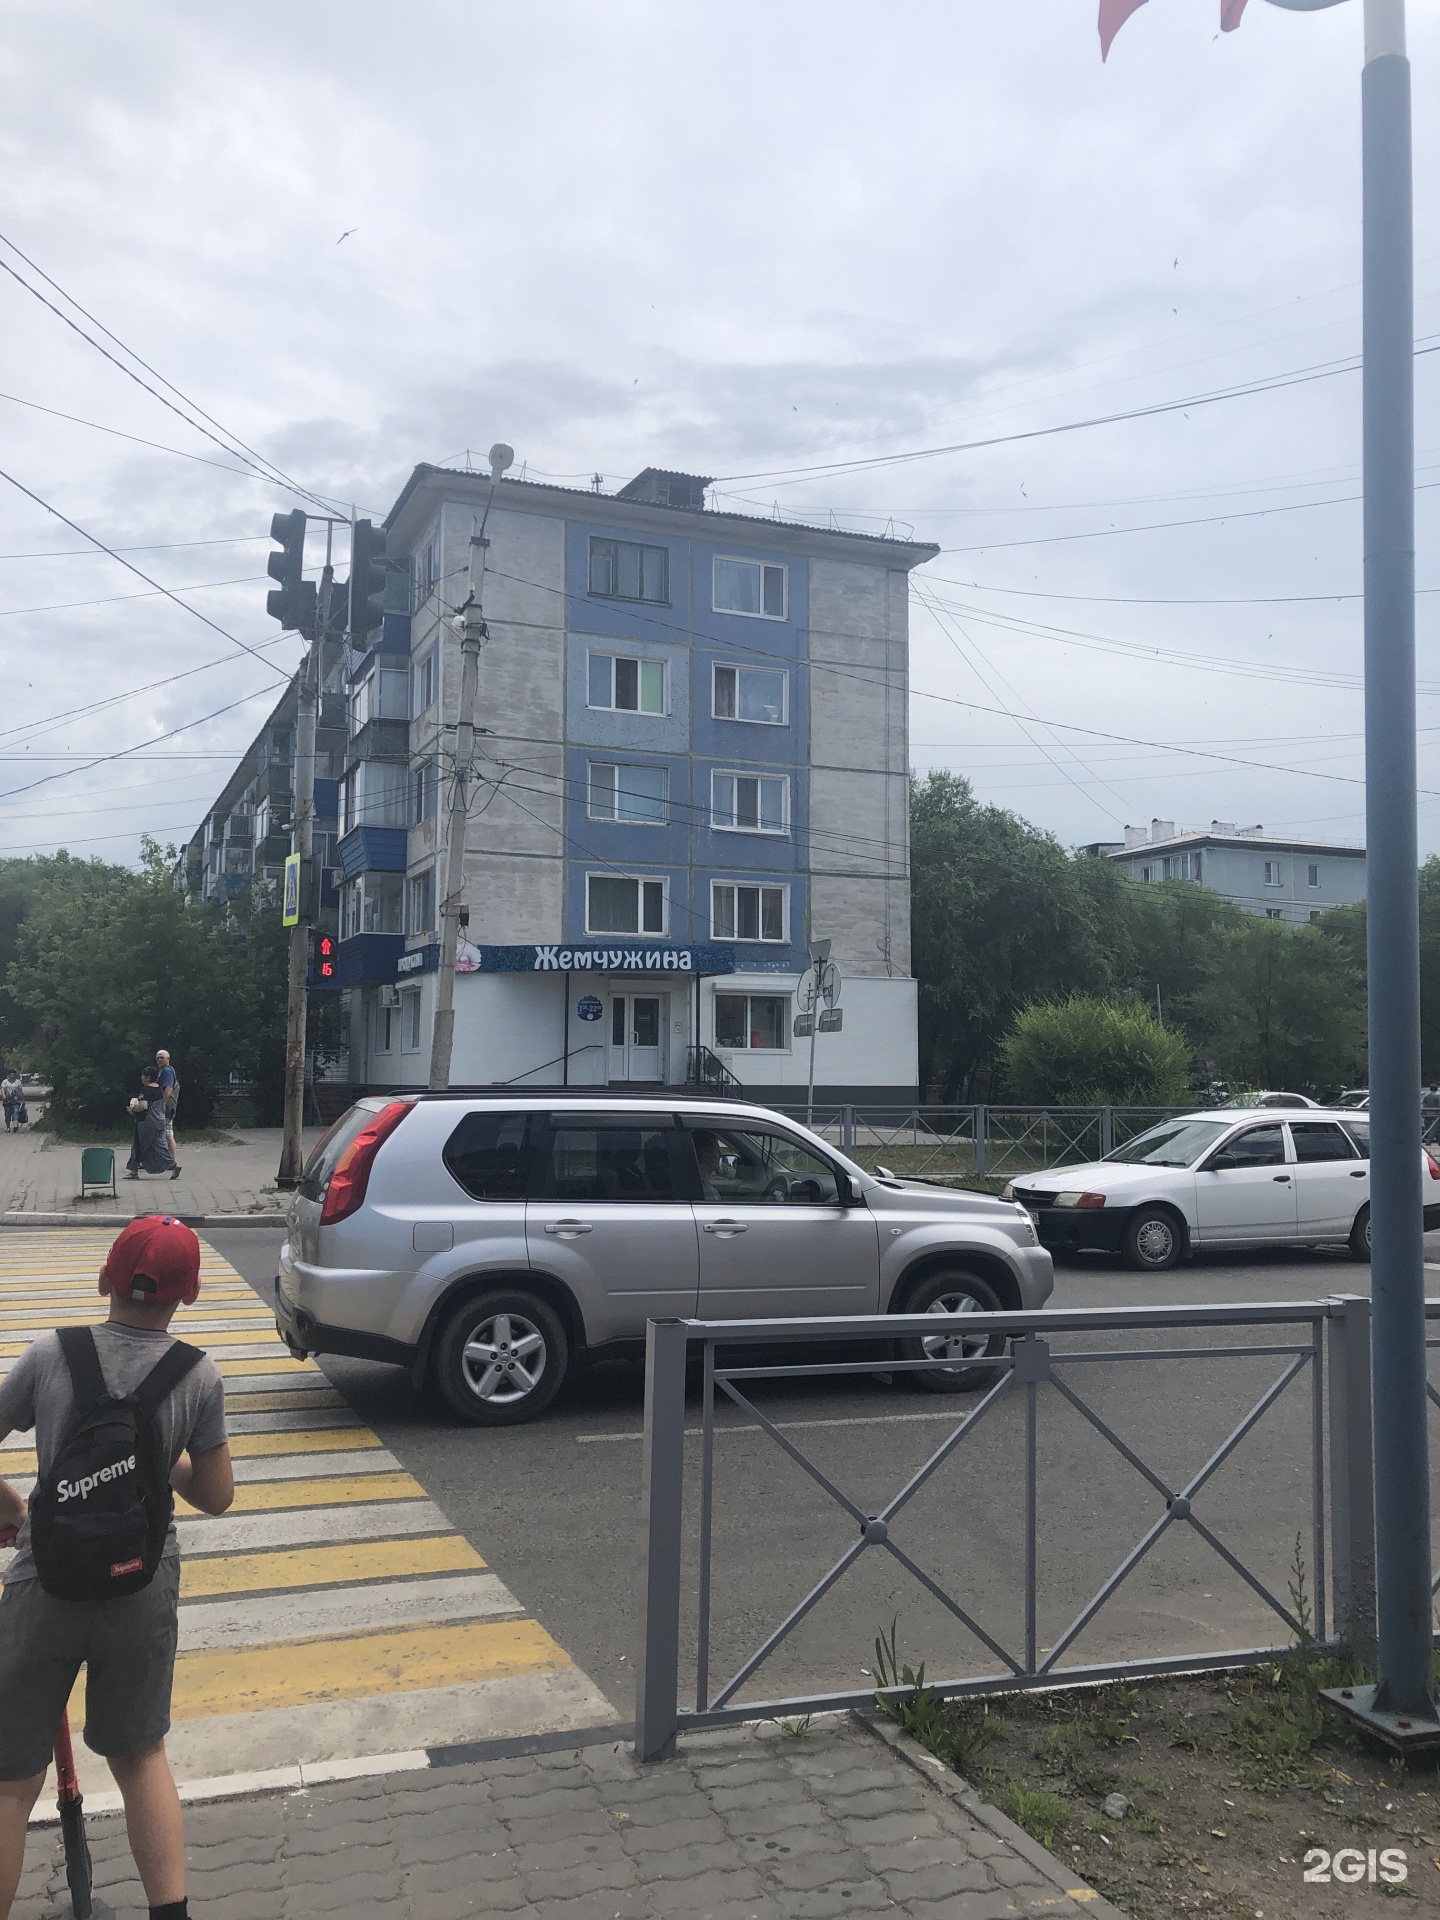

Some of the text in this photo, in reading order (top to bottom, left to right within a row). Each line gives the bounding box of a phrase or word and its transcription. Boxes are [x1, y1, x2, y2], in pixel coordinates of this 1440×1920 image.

[534, 946, 692, 971] Жемчужина
[322, 962, 333, 976] 16
[57, 1455, 136, 1503] Supreme
[114, 1561, 140, 1573] Supreme
